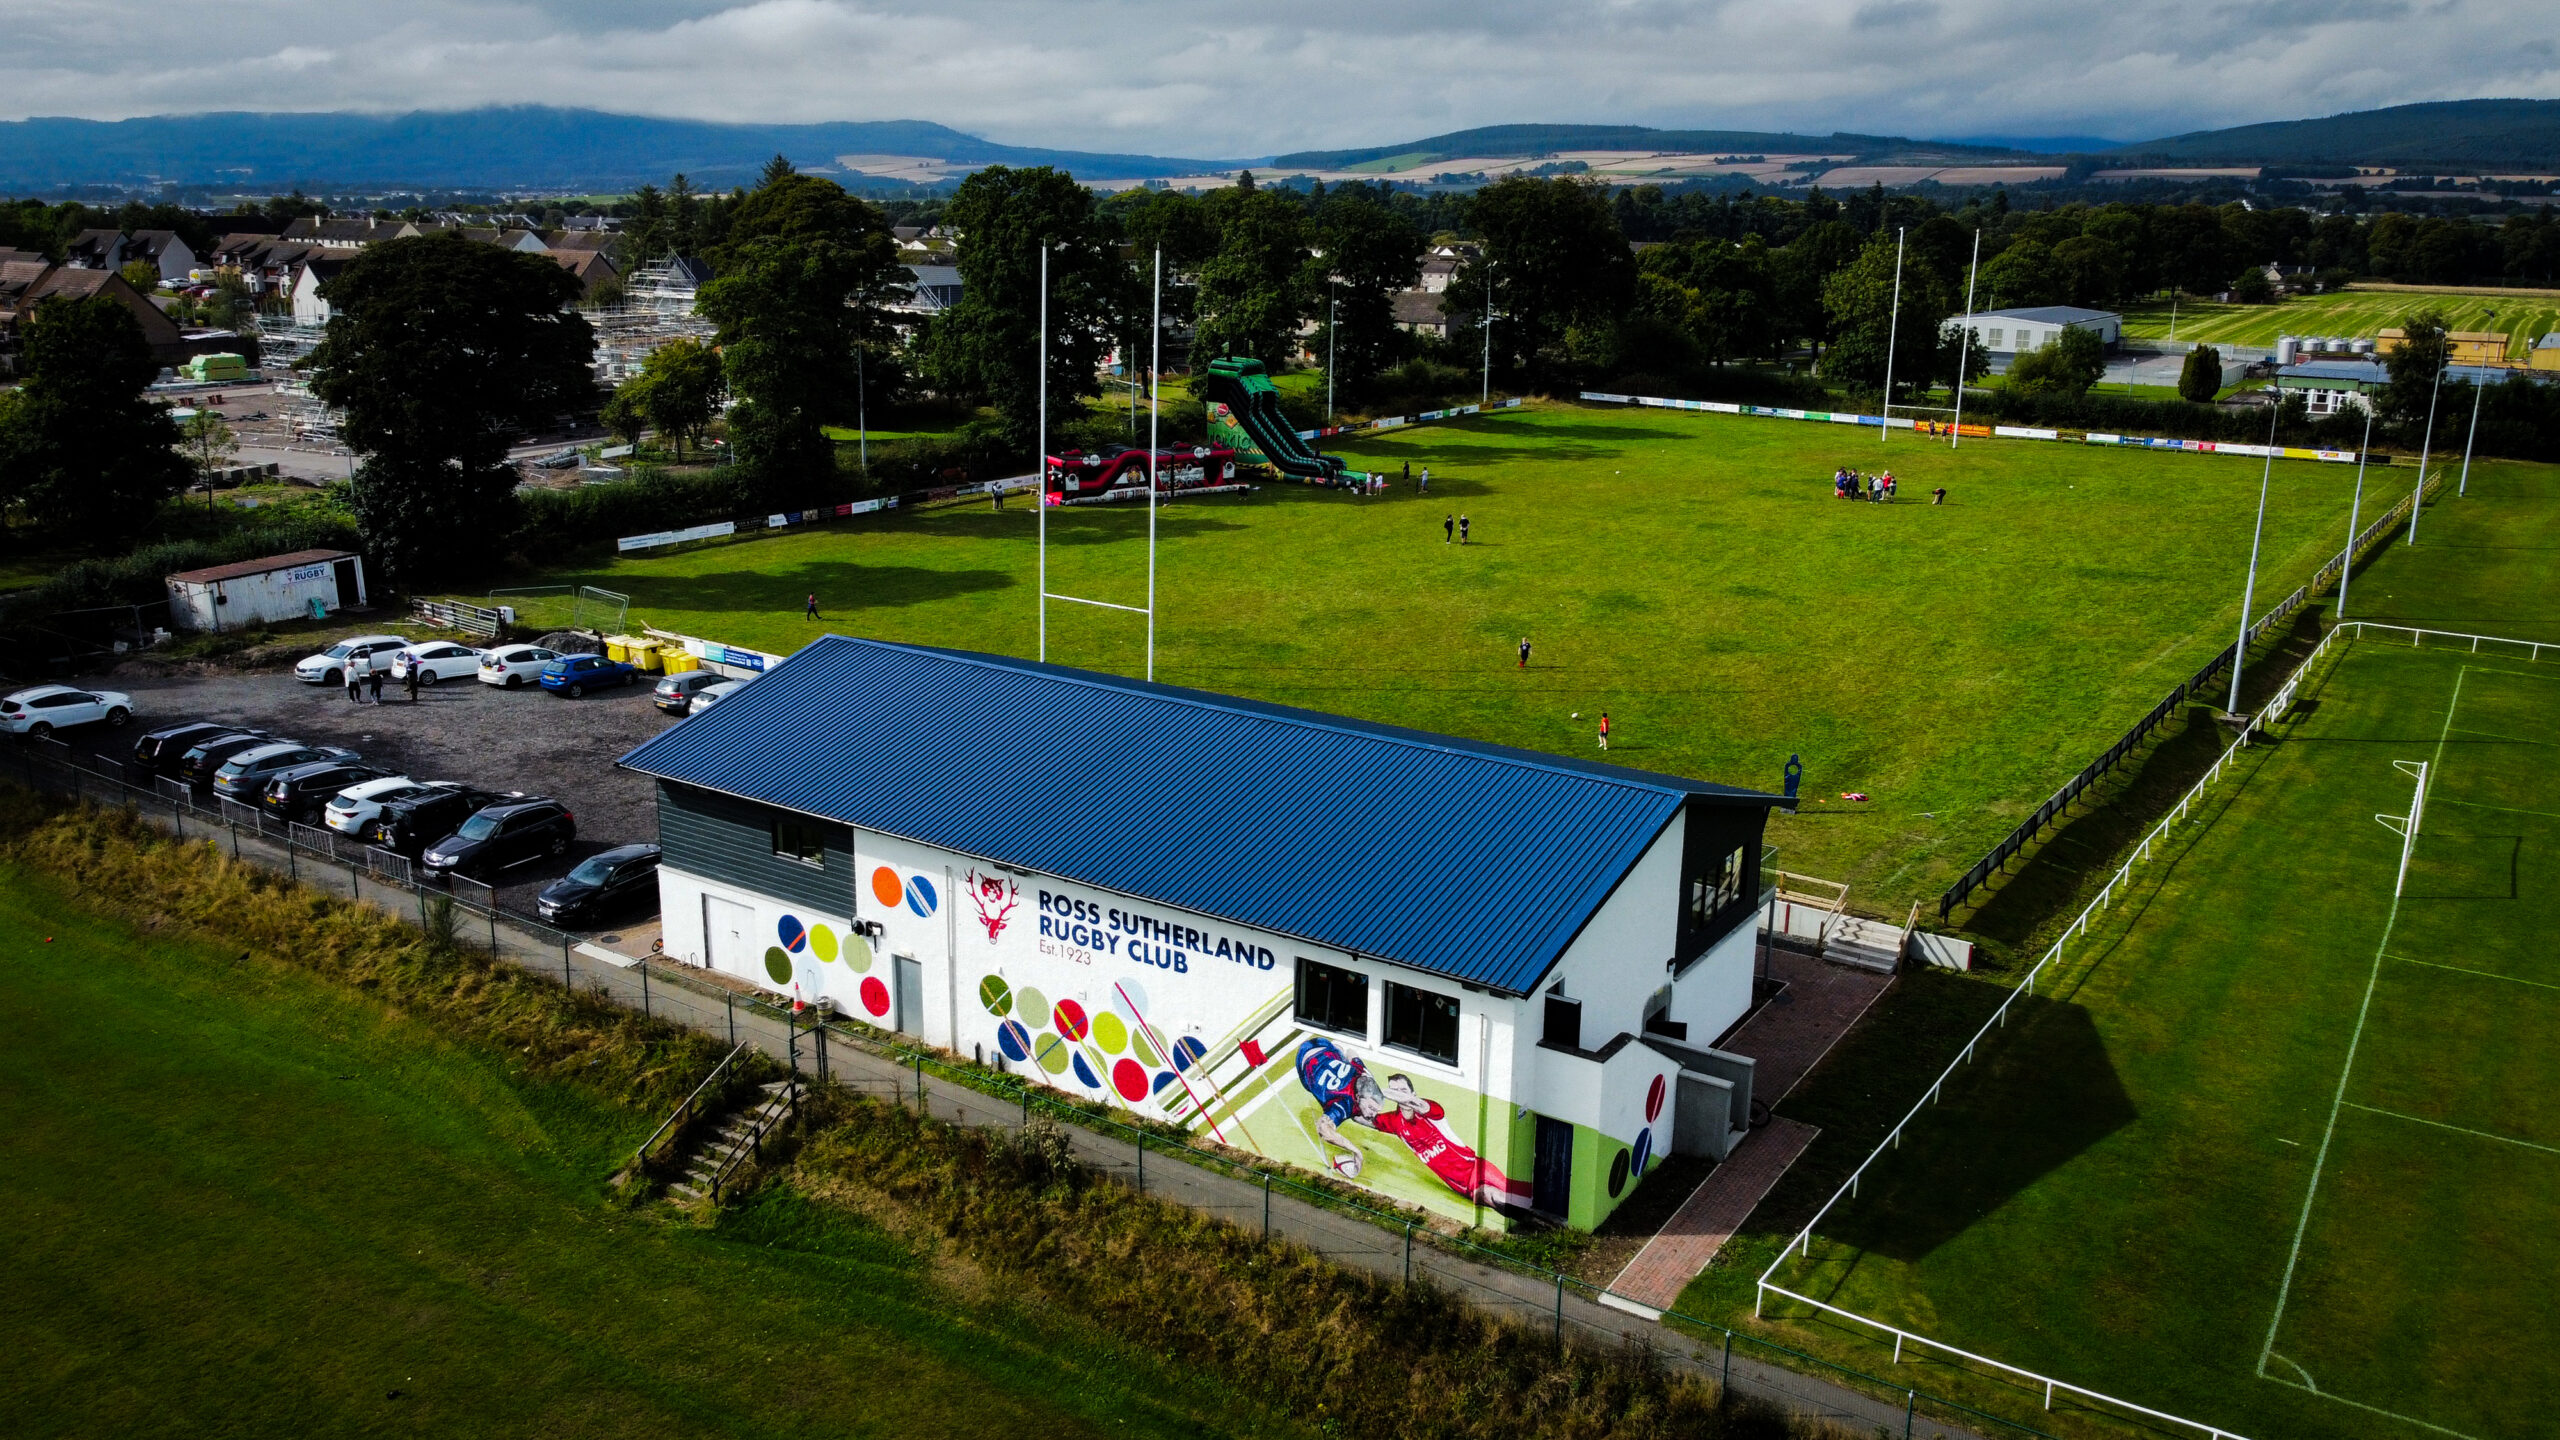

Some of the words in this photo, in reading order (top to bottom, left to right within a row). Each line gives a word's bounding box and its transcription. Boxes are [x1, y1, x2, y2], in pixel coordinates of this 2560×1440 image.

[294, 568, 325, 581] RUGBY
[1039, 889, 1099, 925] ROSS
[1108, 908, 1274, 971] SUTHERLAND
[1039, 914, 1120, 954] RUGBY
[1127, 939, 1188, 974] CLUB
[1318, 1059, 1350, 1091] 22
